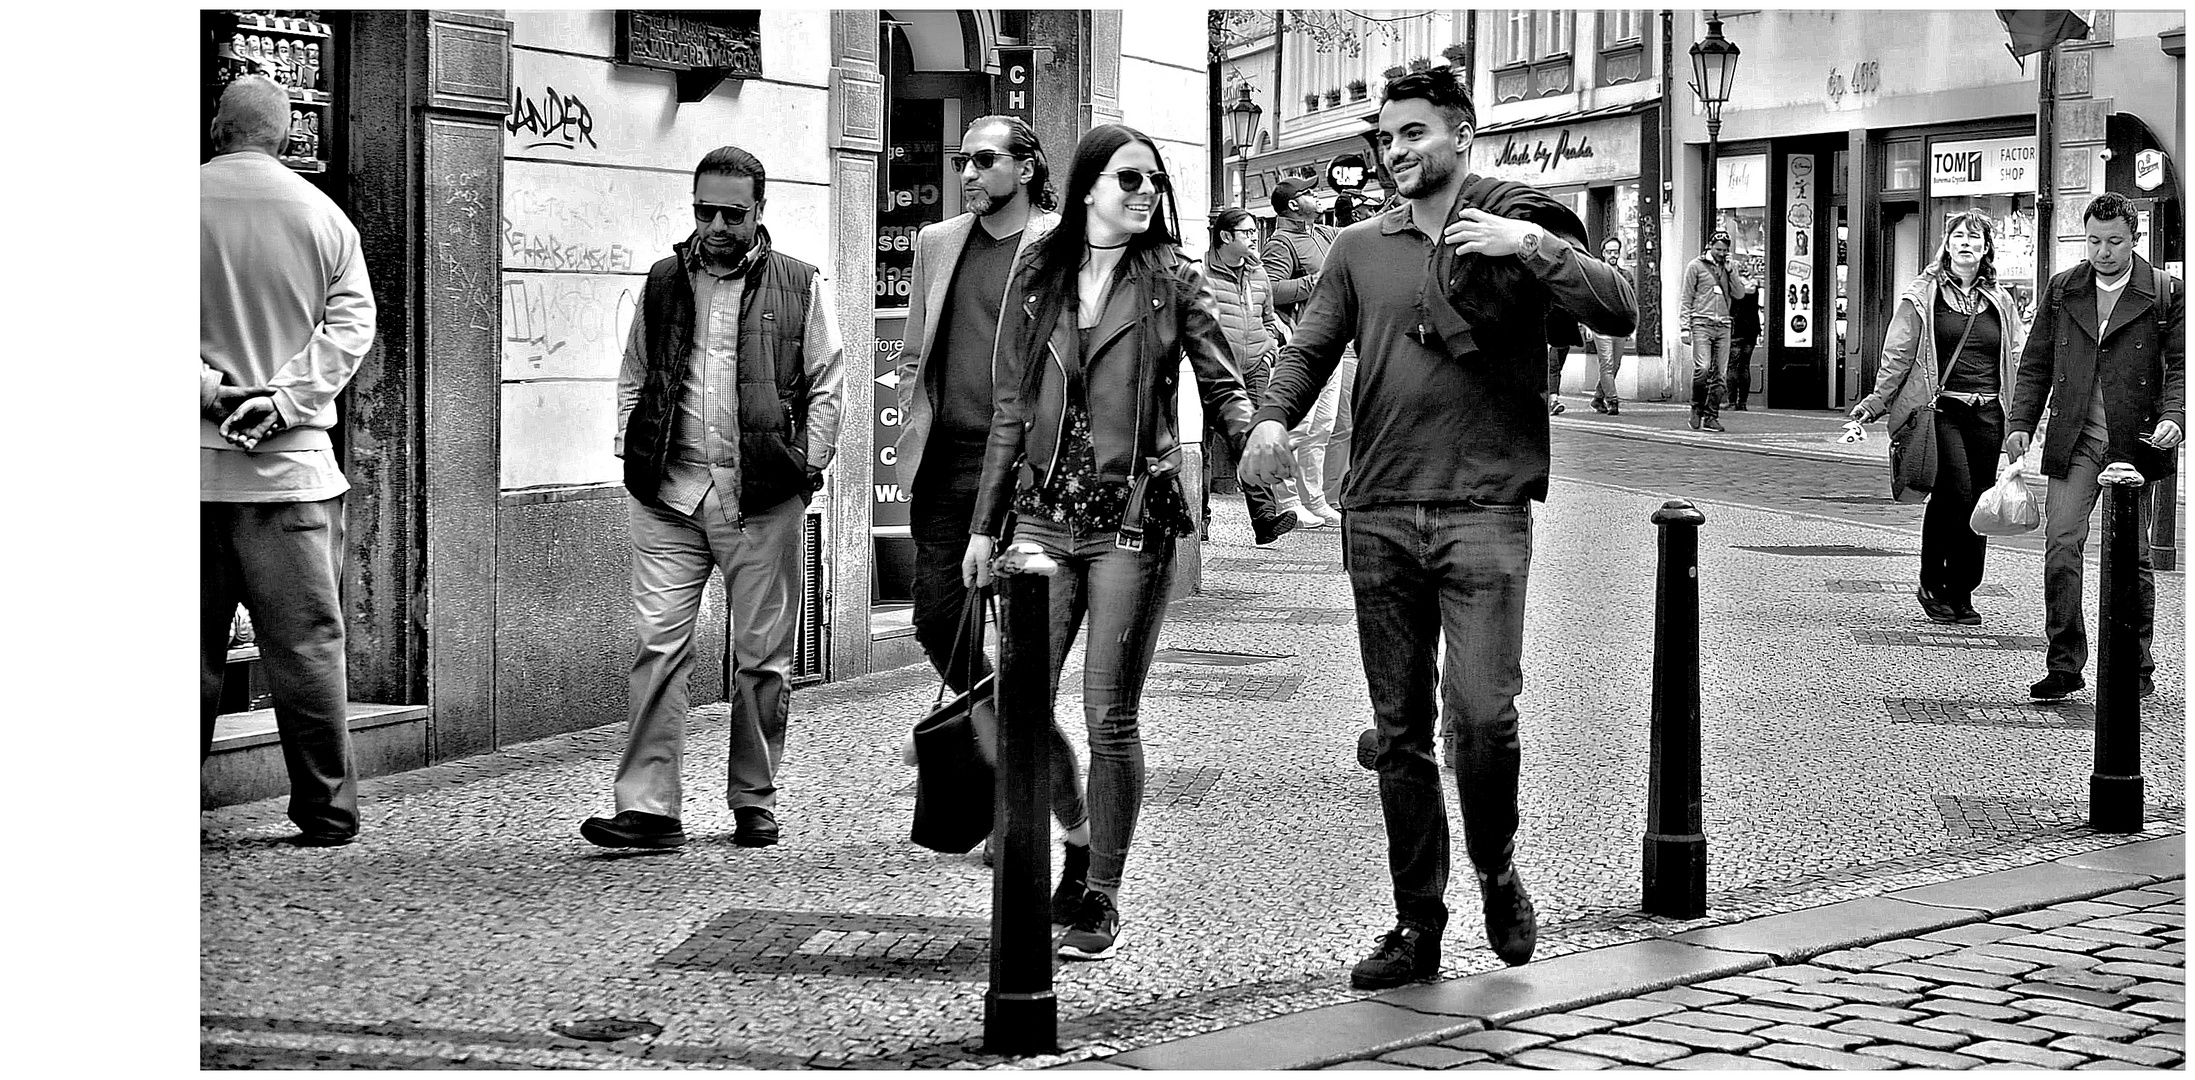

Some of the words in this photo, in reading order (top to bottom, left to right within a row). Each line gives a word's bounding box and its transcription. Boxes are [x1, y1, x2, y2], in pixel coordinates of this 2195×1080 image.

[1009, 65, 1025, 109] CH
[1934, 152, 1966, 173] TOM
[2000, 147, 2036, 161] FACTOR
[2000, 167, 2024, 181] SHOP
